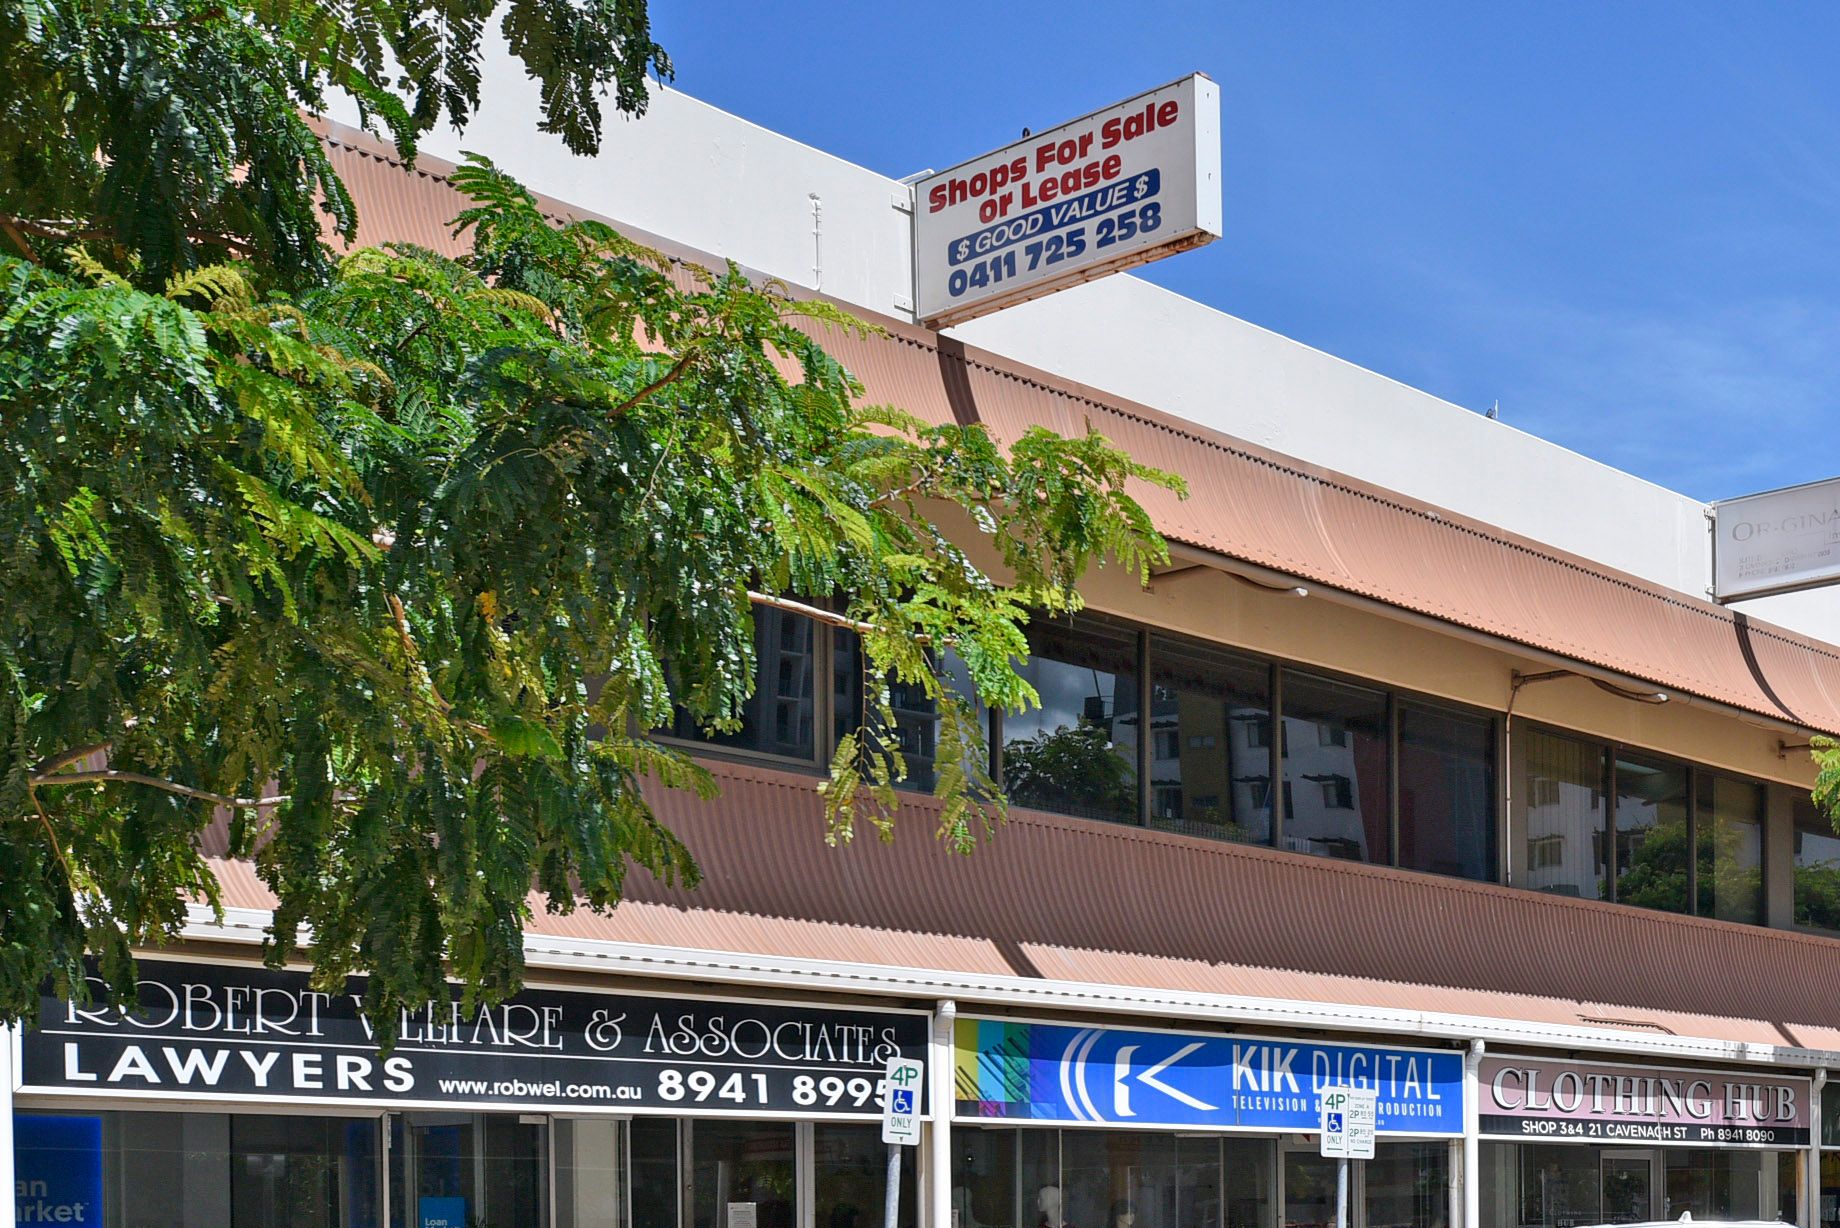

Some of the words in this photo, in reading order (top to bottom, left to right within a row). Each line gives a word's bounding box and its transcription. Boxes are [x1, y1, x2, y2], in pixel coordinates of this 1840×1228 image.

[928, 155, 1027, 214] Shops
[1035, 130, 1094, 174] For
[1101, 99, 1179, 150] Sale
[979, 190, 1013, 225] or
[1020, 154, 1122, 210] Lease
[975, 212, 1043, 252] GOOD
[1050, 182, 1129, 227] VALUE
[948, 252, 1017, 298] 0411
[1025, 228, 1087, 272] 725
[1096, 201, 1162, 250] 258
[63, 976, 331, 1037] ROBERT
[584, 1008, 627, 1051] &
[642, 1011, 901, 1066] ASSOCIATES
[64, 1042, 415, 1093] LAWYERS
[438, 1077, 643, 1100] www.robwel.com.au
[657, 1068, 769, 1105] 8941
[890, 1066, 918, 1087] 4P
[1231, 1043, 1300, 1094] KIK
[1311, 1049, 1442, 1100] DIGITAL
[1231, 1094, 1307, 1113] TELEVISION
[1325, 1093, 1346, 1110] 4P
[1378, 1101, 1443, 1117] RODUCTION
[1490, 1065, 1713, 1121] CLOTHING
[1721, 1081, 1798, 1123] HUB
[890, 1116, 913, 1129] ONLY
[1326, 1135, 1343, 1145] ONLY
[1521, 1120, 1557, 1135] SHOP
[1559, 1121, 1583, 1136] 3&4
[1588, 1122, 1602, 1136] 21
[1606, 1122, 1671, 1139] CAVENAGH
[1673, 1126, 1688, 1139] ST
[1700, 1127, 1715, 1141] Ph
[1717, 1128, 1744, 1141] 8941
[1745, 1129, 1775, 1142] 8090
[424, 1217, 448, 1227] Loan
